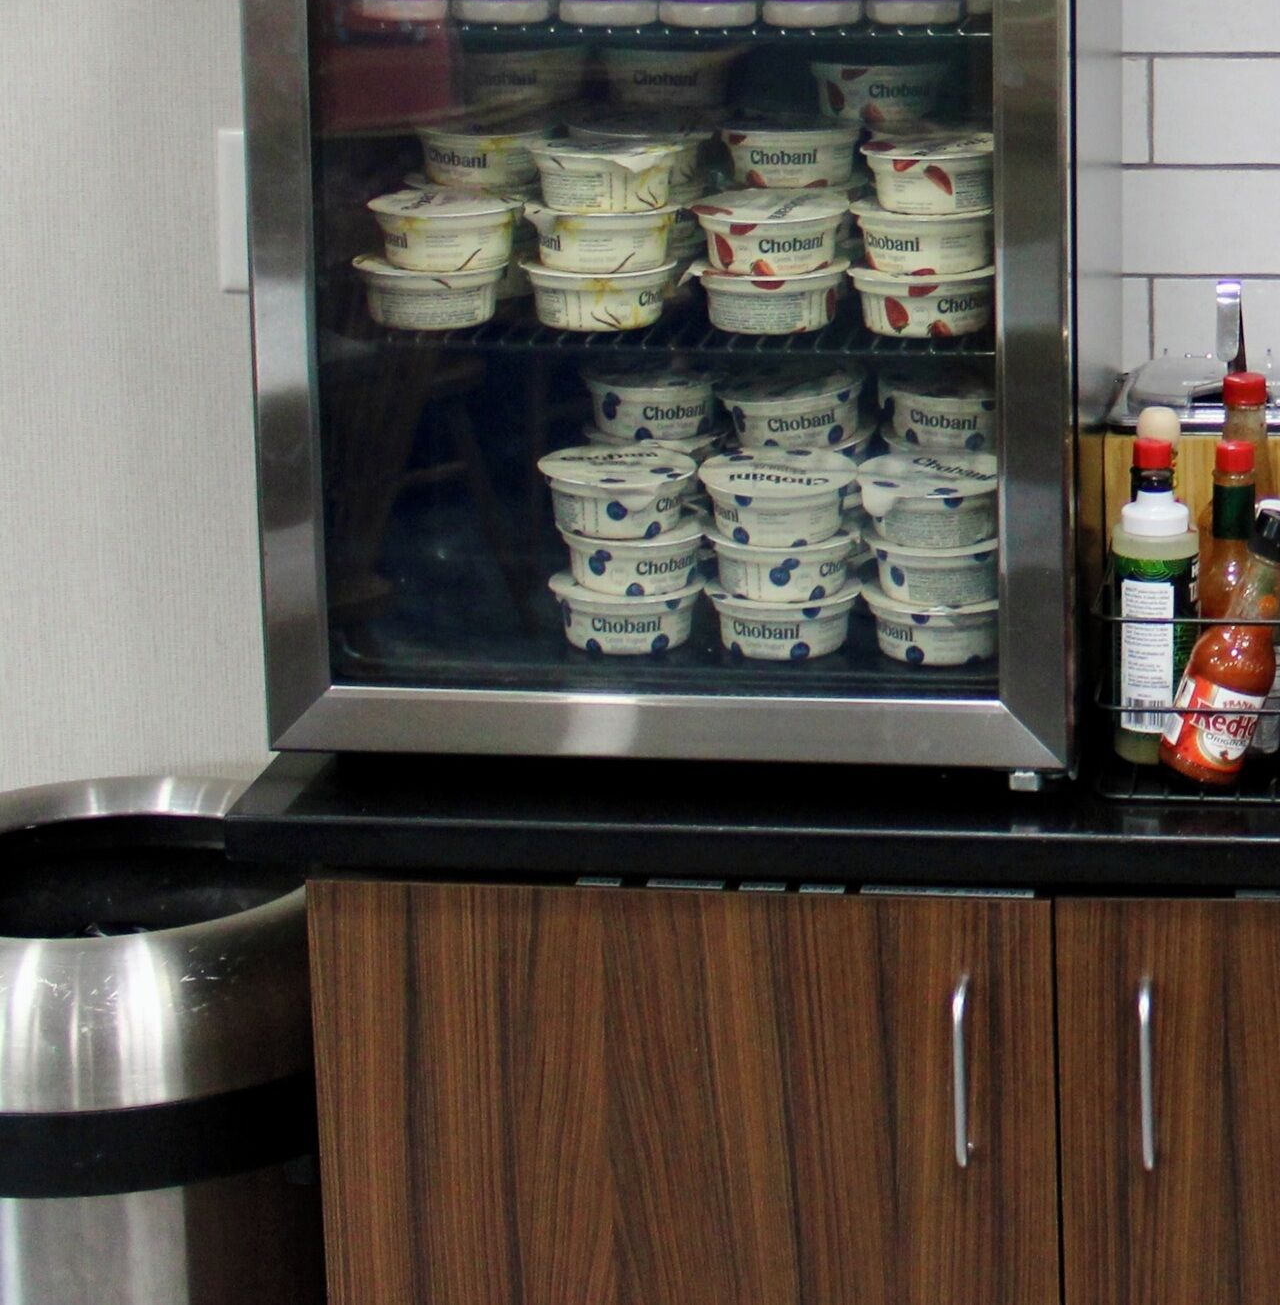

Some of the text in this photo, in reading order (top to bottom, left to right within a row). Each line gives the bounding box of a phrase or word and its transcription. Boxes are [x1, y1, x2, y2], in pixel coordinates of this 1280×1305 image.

[749, 148, 818, 166] Chobani
[758, 231, 825, 254] Chobani
[642, 403, 707, 421] Chobani
[767, 408, 836, 433] Chobani
[910, 408, 978, 431] Chobani
[591, 616, 662, 634] Chobani
[733, 620, 801, 641] Chobani
